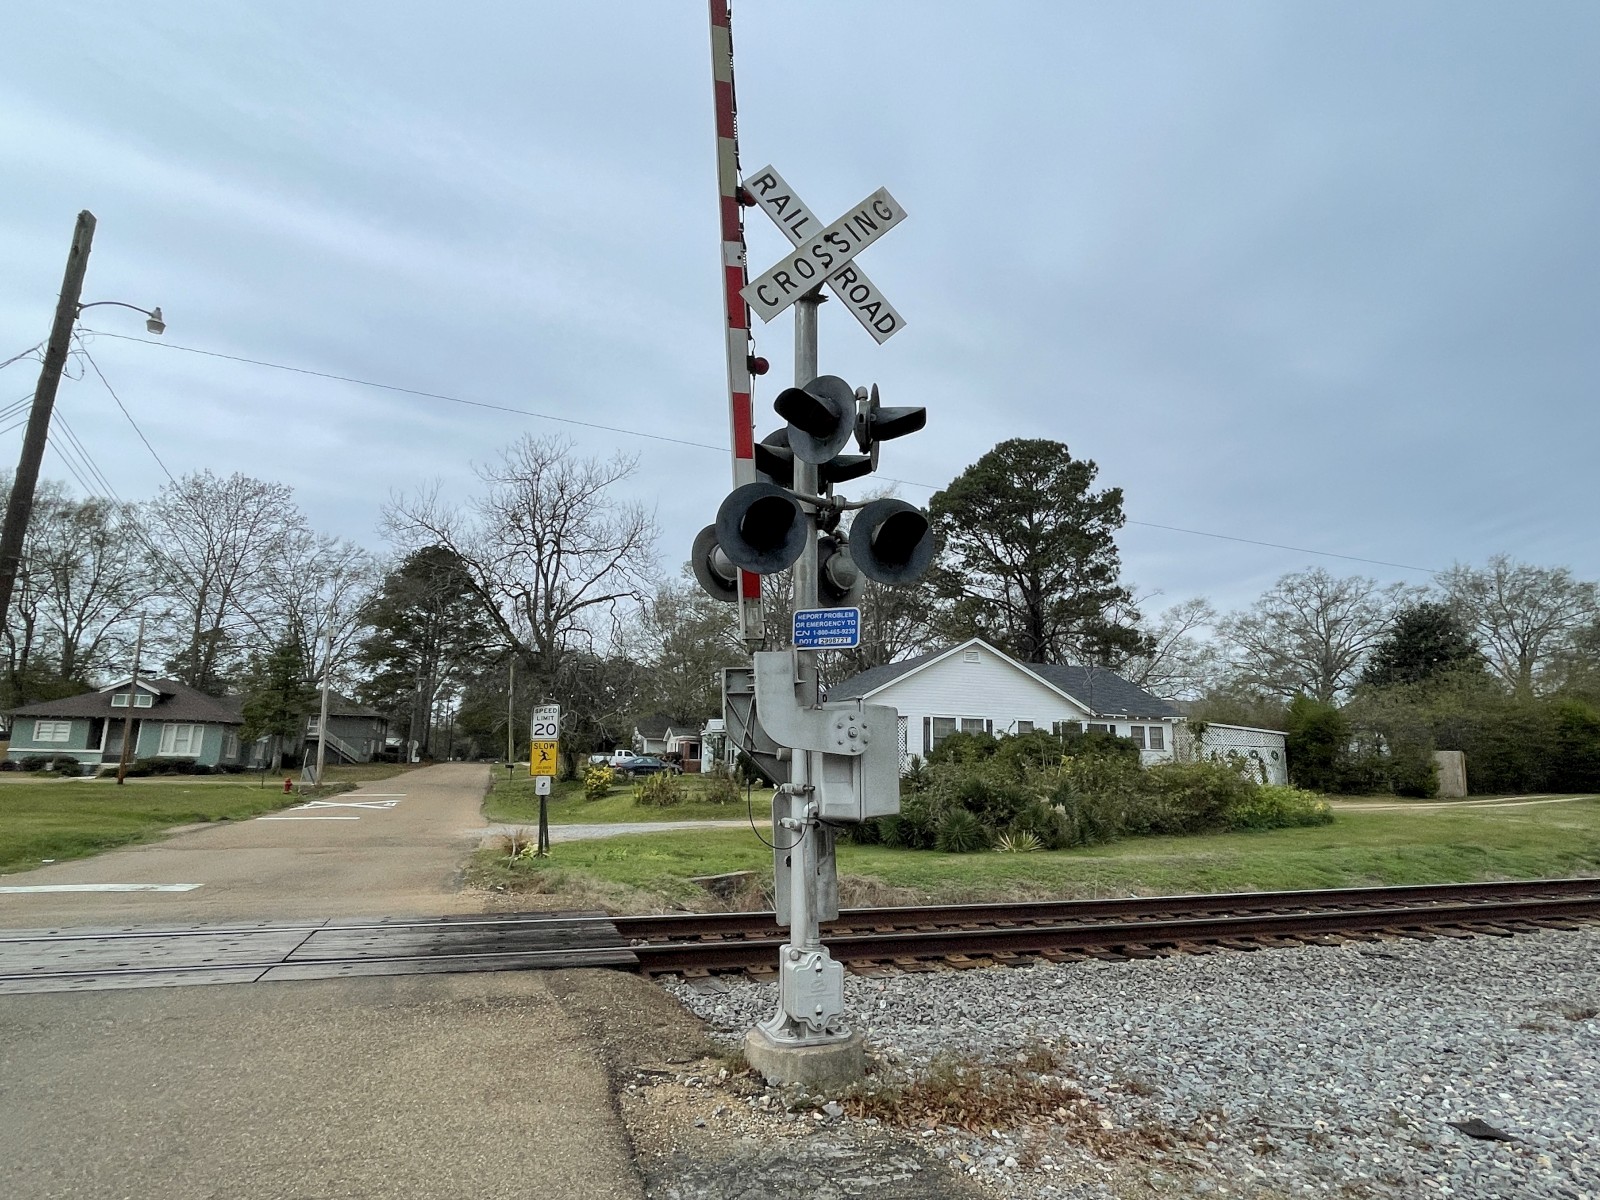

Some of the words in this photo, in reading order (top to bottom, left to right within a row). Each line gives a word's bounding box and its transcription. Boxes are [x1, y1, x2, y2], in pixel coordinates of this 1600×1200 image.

[752, 173, 809, 239] RAIL
[756, 200, 893, 306] CROSSING
[833, 266, 896, 334] ROAD
[806, 620, 845, 628] EMERGENCY
[534, 723, 557, 736] 20
